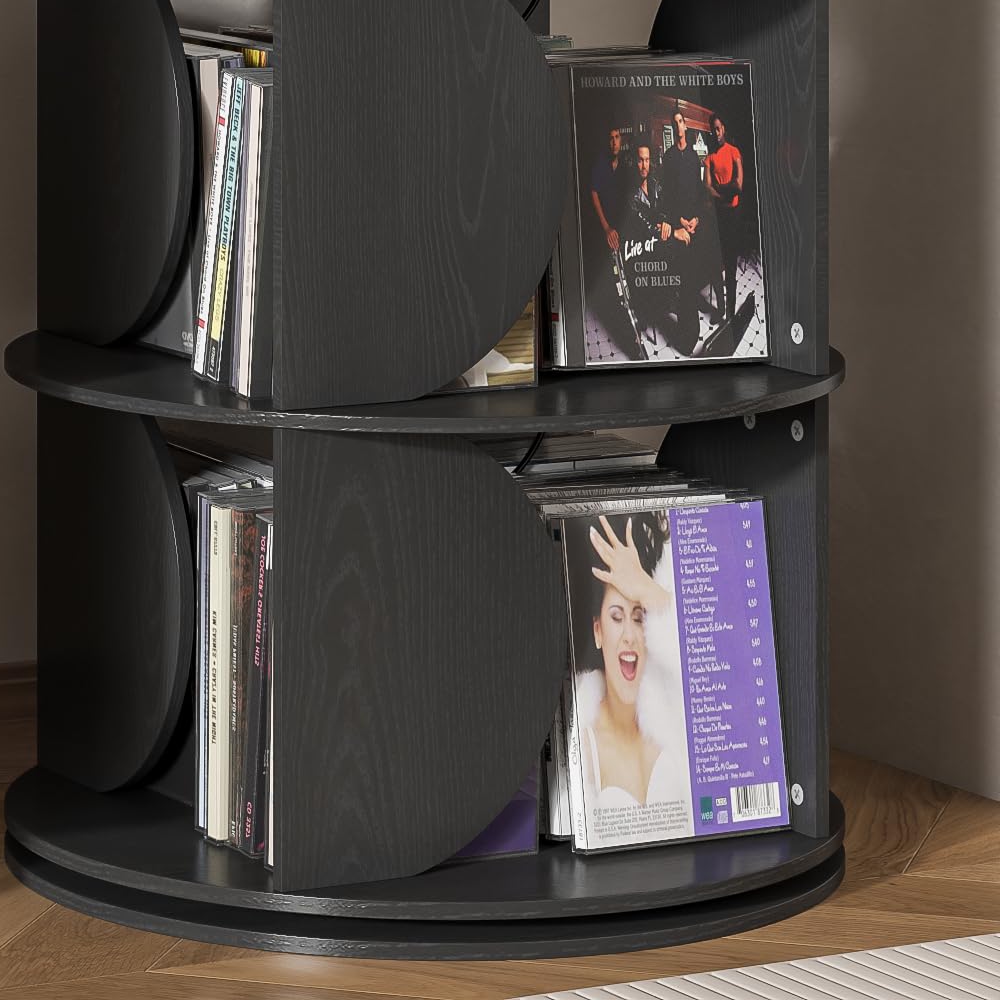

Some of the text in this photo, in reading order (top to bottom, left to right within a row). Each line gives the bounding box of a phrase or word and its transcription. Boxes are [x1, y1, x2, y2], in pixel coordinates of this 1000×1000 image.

[581, 74, 744, 89] HOWARD AND THE WHITE BOYS
[232, 108, 240, 132] BECK
[224, 186, 233, 212] TOWN
[220, 216, 230, 261] PLAYBOYS
[625, 236, 658, 261] Live at
[634, 261, 668, 272] CHORD
[635, 275, 681, 287] ON BLUES
